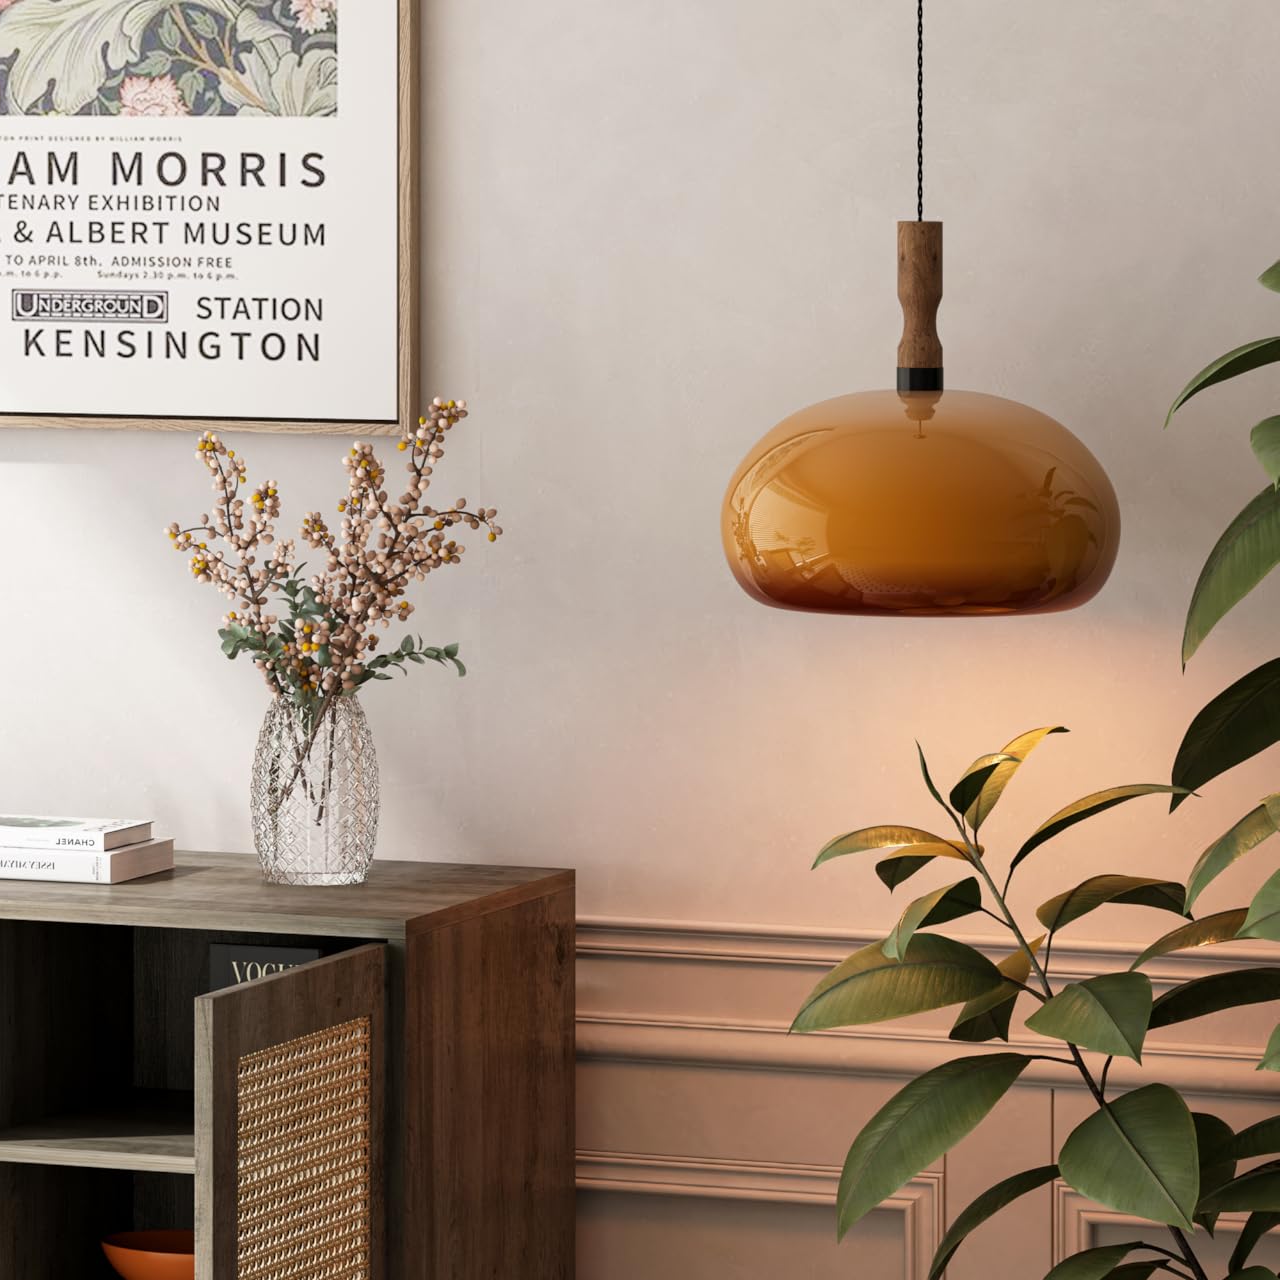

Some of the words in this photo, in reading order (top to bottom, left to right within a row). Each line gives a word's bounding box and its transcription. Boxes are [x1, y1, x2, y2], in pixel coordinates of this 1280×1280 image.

[111, 151, 326, 188] MORRIS
[88, 194, 220, 212] EXHIBITION
[13, 219, 34, 244] &
[46, 220, 170, 245] ALBERT
[183, 222, 326, 246] MUSEUM
[5, 255, 24, 266] TO
[29, 255, 69, 267] APRIL
[111, 256, 192, 268] ADMISSION
[197, 257, 233, 269] FREE
[97, 270, 139, 280] Sundays
[16, 293, 164, 318] UNDERGROUND
[196, 297, 323, 322] STATION
[24, 328, 320, 363] KENSINGTON
